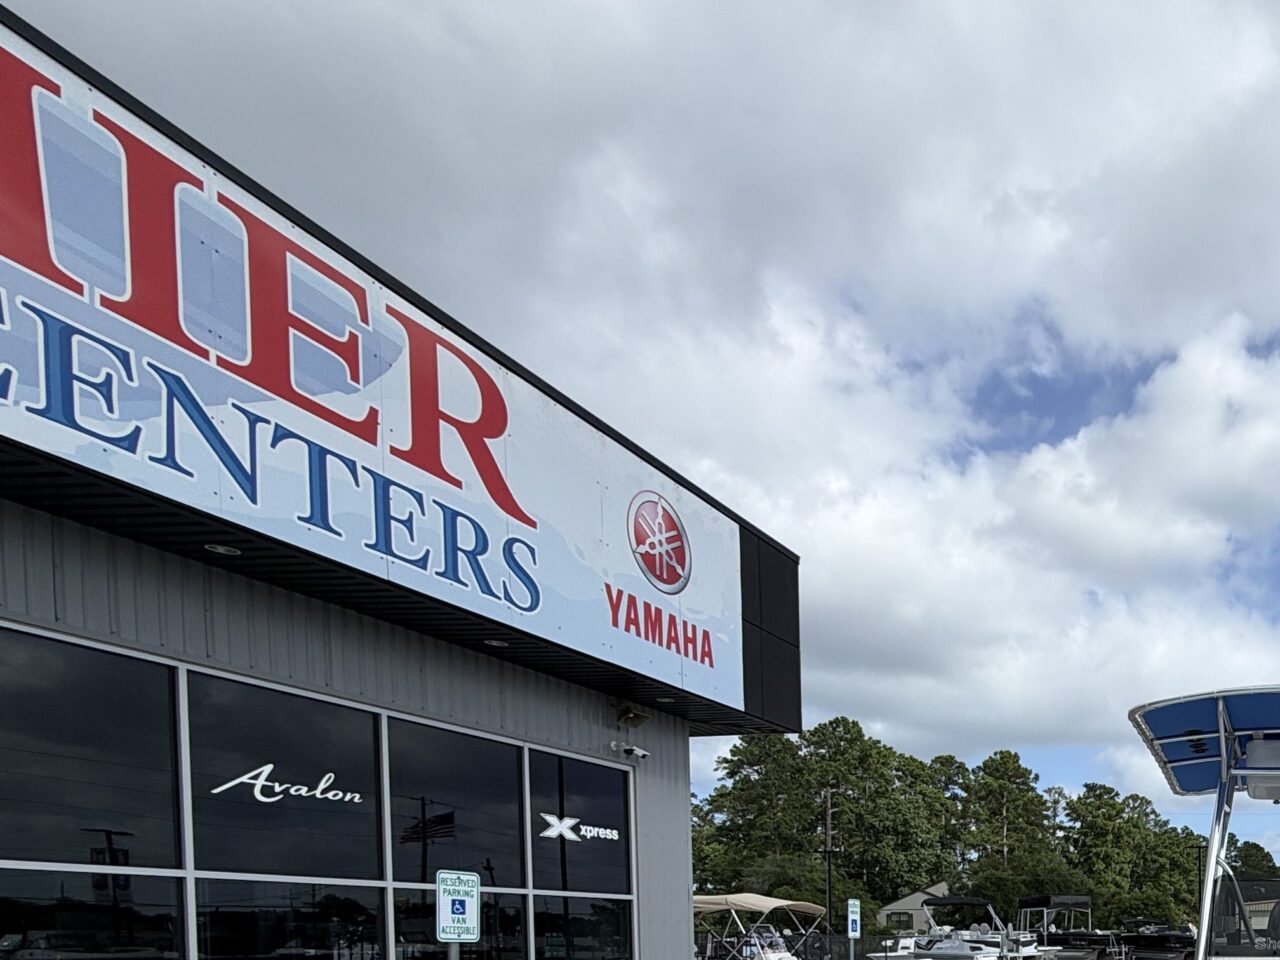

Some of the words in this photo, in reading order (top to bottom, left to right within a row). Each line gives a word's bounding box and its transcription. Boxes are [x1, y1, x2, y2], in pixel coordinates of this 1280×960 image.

[0, 47, 538, 529] IER
[0, 287, 541, 613] ENTERS
[604, 582, 715, 669] YAMAHA
[210, 763, 363, 803] Avalon
[580, 824, 619, 841] xpress
[440, 876, 477, 889] RESERVED
[442, 887, 475, 899] PARKING
[451, 916, 467, 925] VAN
[441, 925, 476, 936] ACCESSIBLE
